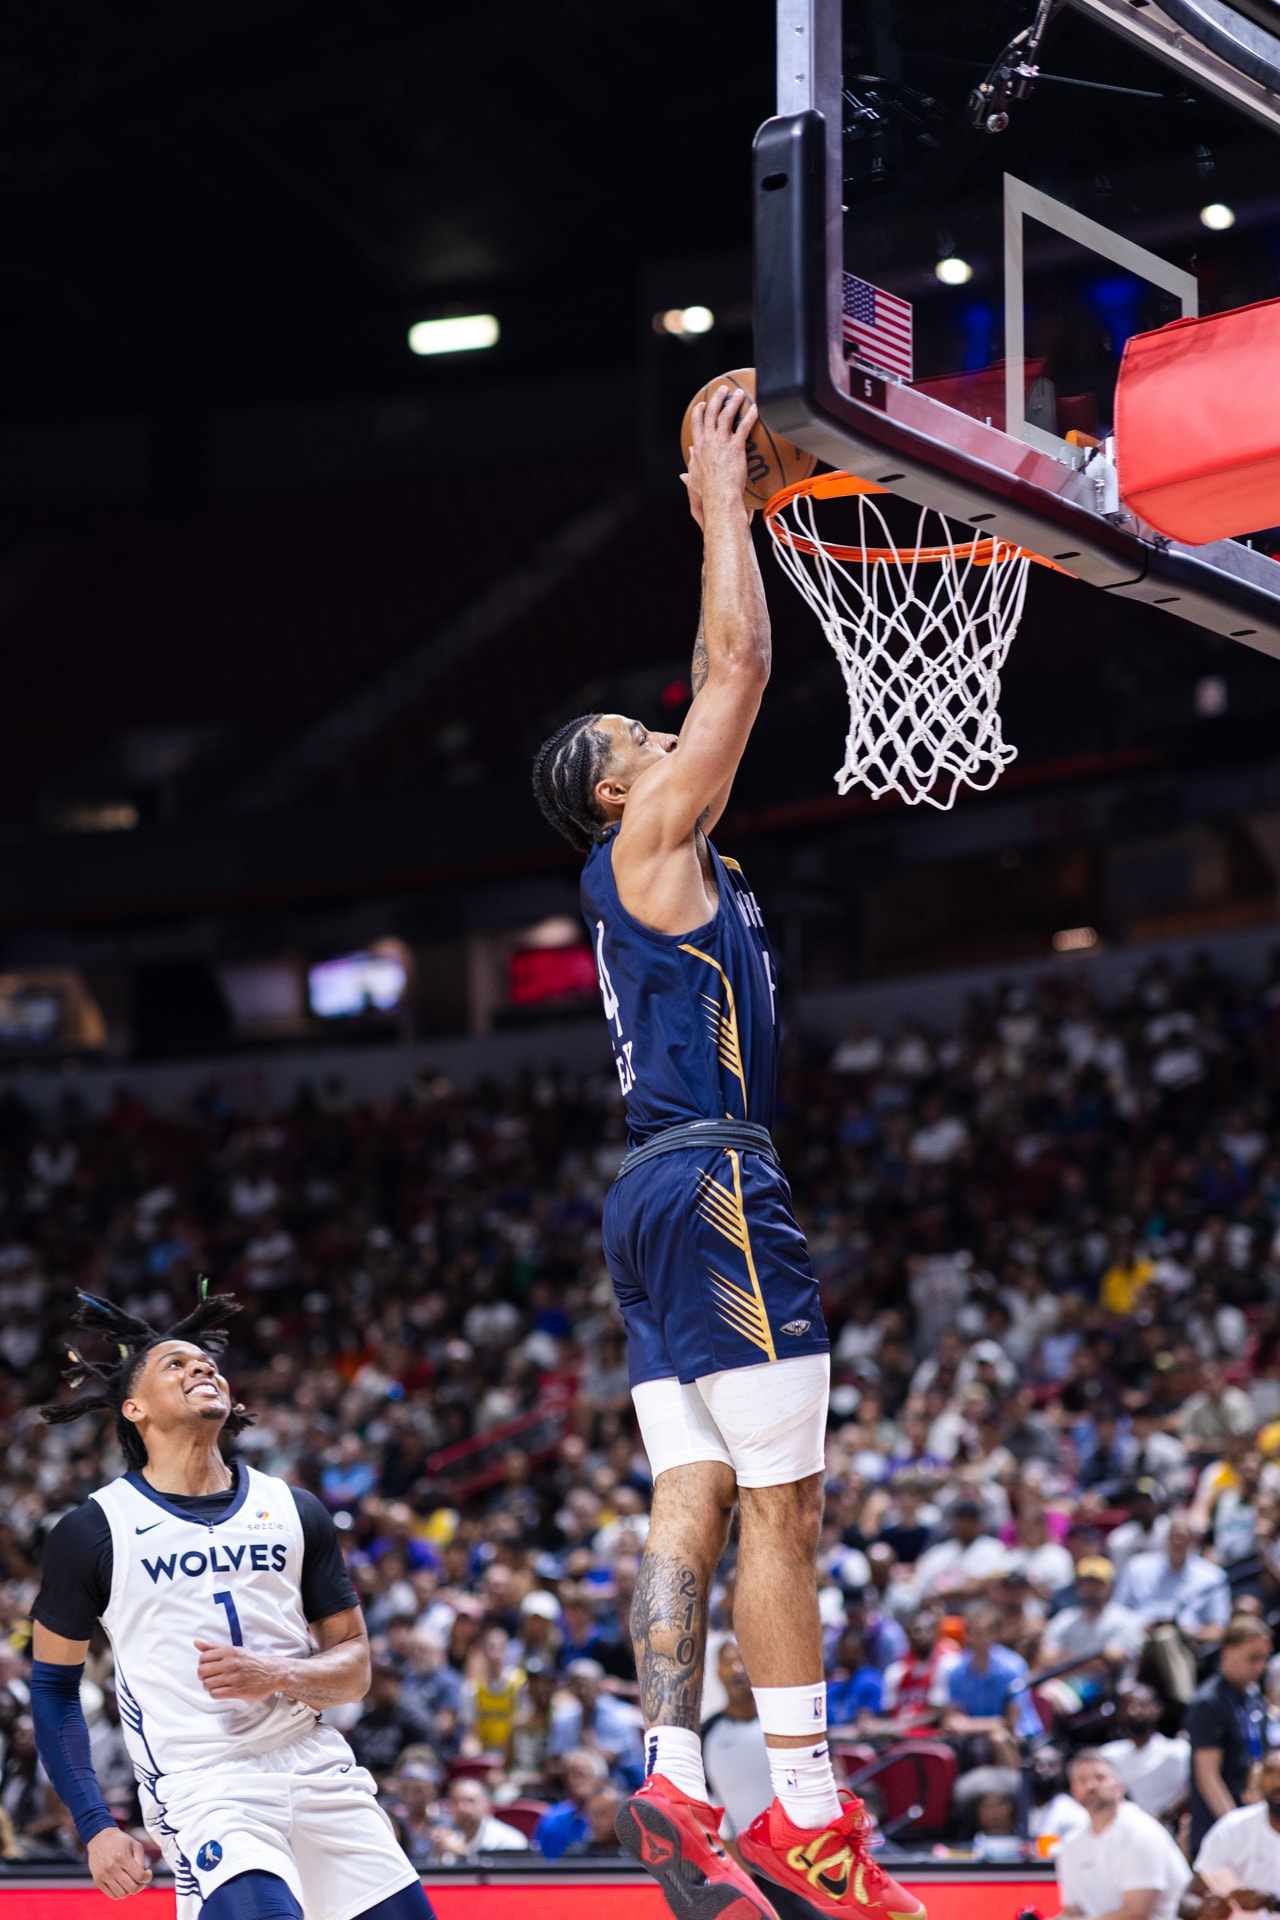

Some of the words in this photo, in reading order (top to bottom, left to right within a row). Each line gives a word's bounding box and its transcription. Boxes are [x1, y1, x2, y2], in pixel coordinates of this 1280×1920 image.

[864, 378, 873, 397] 5
[247, 1521, 284, 1531] sezzle
[140, 1543, 288, 1585] WOLVES
[212, 1590, 244, 1647] 1
